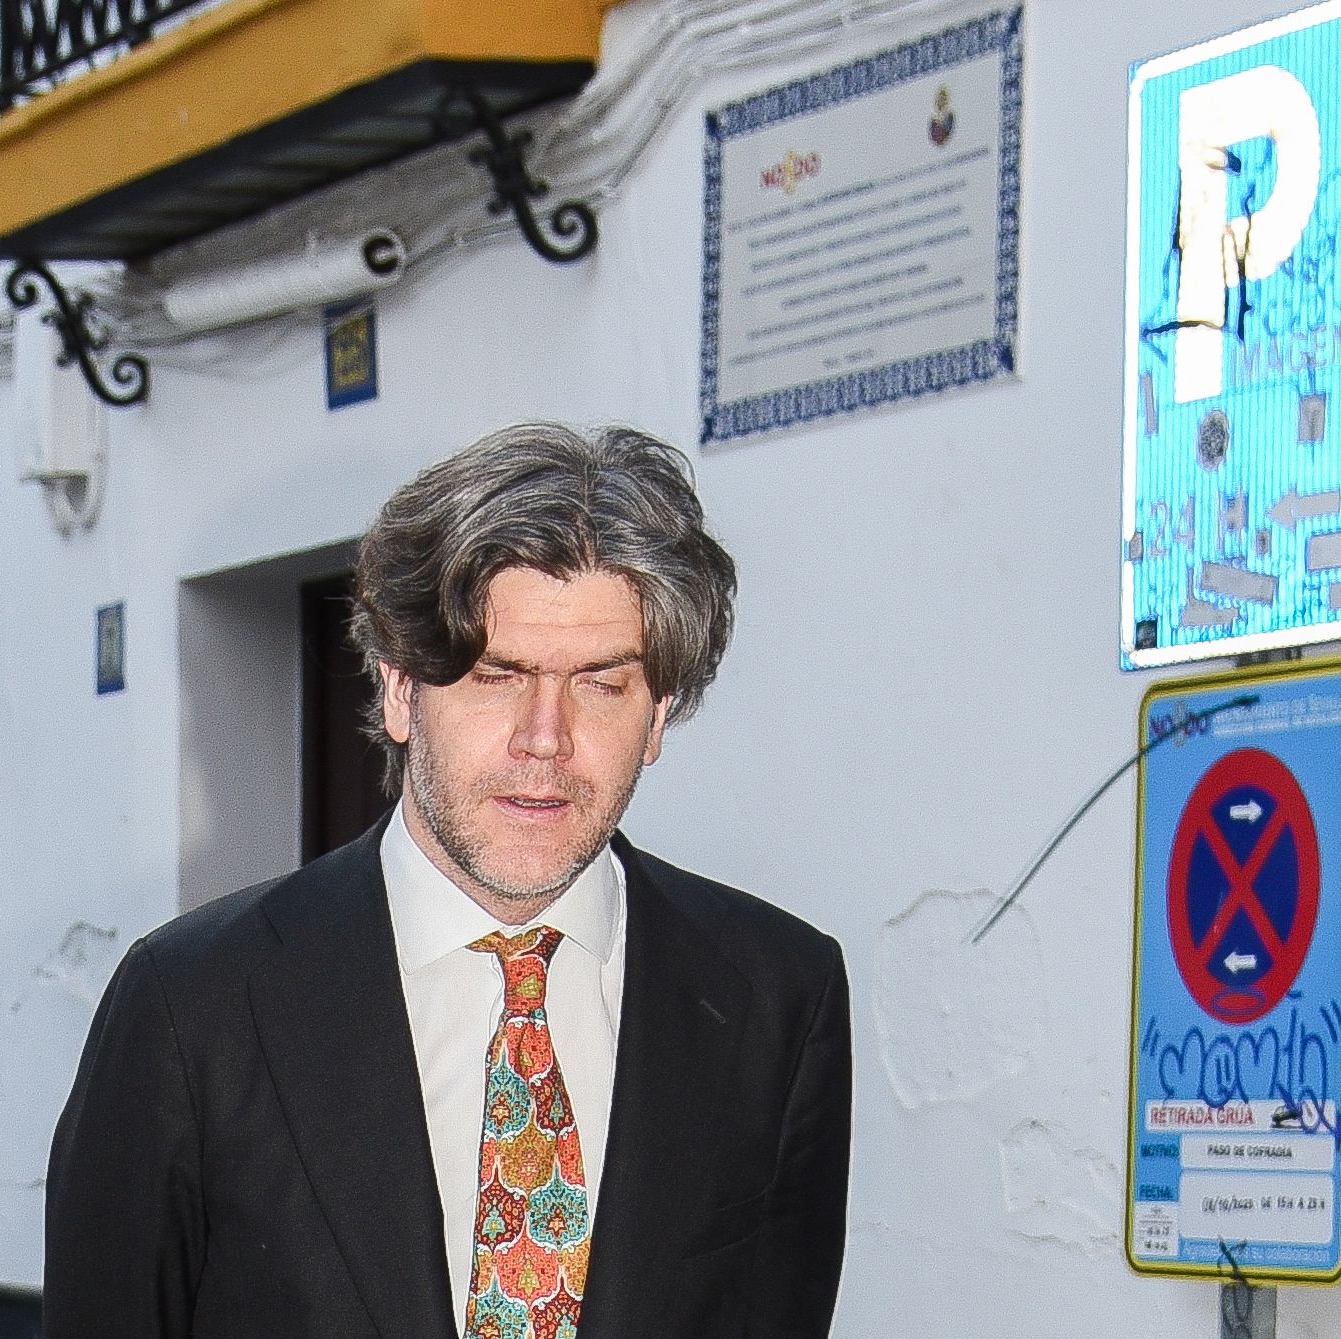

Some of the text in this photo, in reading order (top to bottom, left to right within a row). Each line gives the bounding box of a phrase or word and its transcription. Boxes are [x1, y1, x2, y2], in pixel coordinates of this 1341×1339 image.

[1175, 62, 1321, 404] P
[1150, 1106, 1213, 1125] RETIRADA
[1208, 1144, 1231, 1156] PASO
[1234, 1145, 1246, 1157] DE
